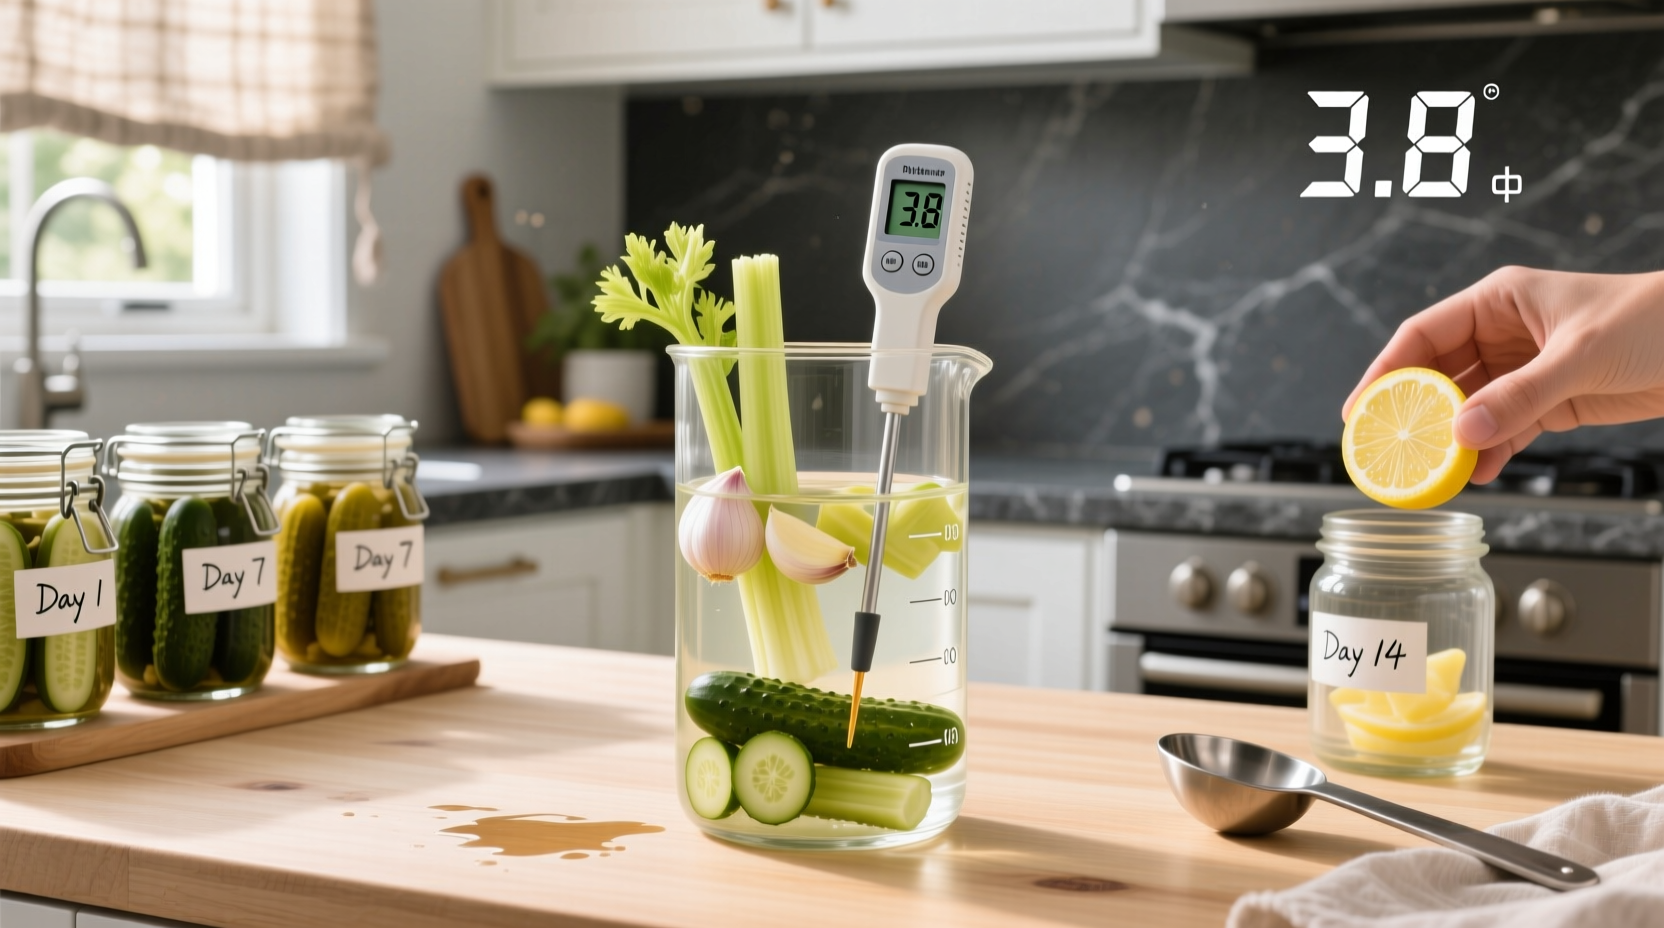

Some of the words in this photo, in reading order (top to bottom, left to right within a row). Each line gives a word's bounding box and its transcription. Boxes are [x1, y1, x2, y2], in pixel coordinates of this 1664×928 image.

[899, 191, 943, 228] 3.8
[202, 563, 245, 599] Day
[252, 557, 265, 585] 7
[353, 544, 394, 579] Day
[399, 540, 413, 568] 7
[36, 583, 86, 623] Day
[96, 579, 103, 607] 1
[1323, 630, 1364, 678] Day
[1374, 639, 1407, 670] 14
